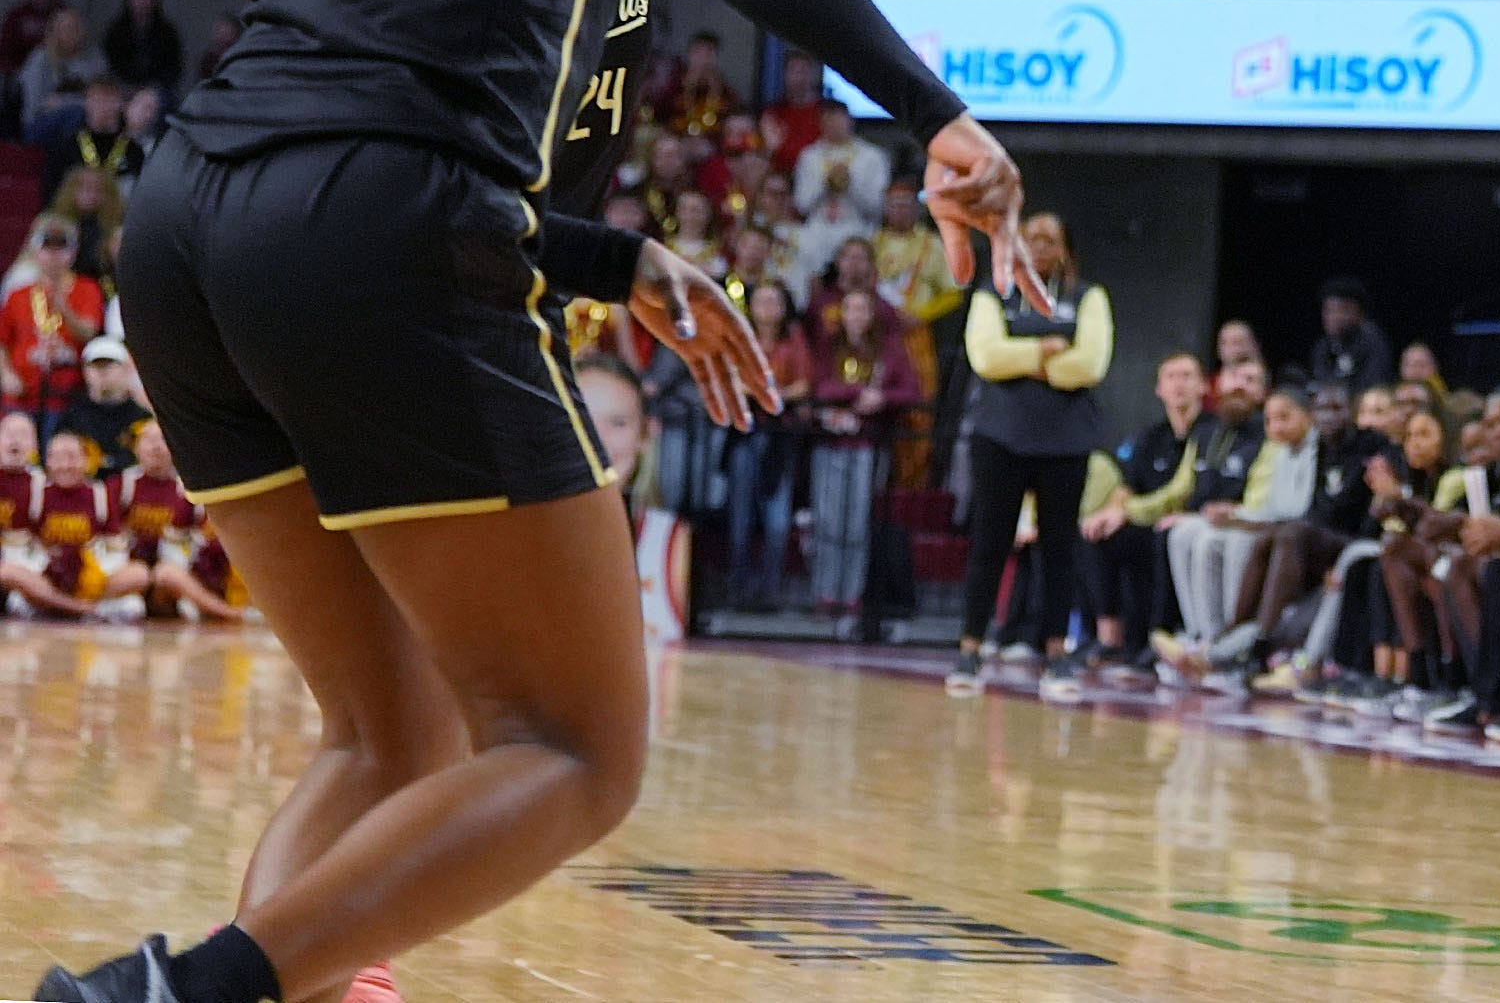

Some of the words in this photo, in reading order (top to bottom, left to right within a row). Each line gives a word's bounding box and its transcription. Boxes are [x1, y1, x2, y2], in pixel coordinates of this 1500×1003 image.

[943, 49, 1084, 88] HISOY
[1291, 54, 1442, 94] HISOY
[566, 67, 627, 141] 24
